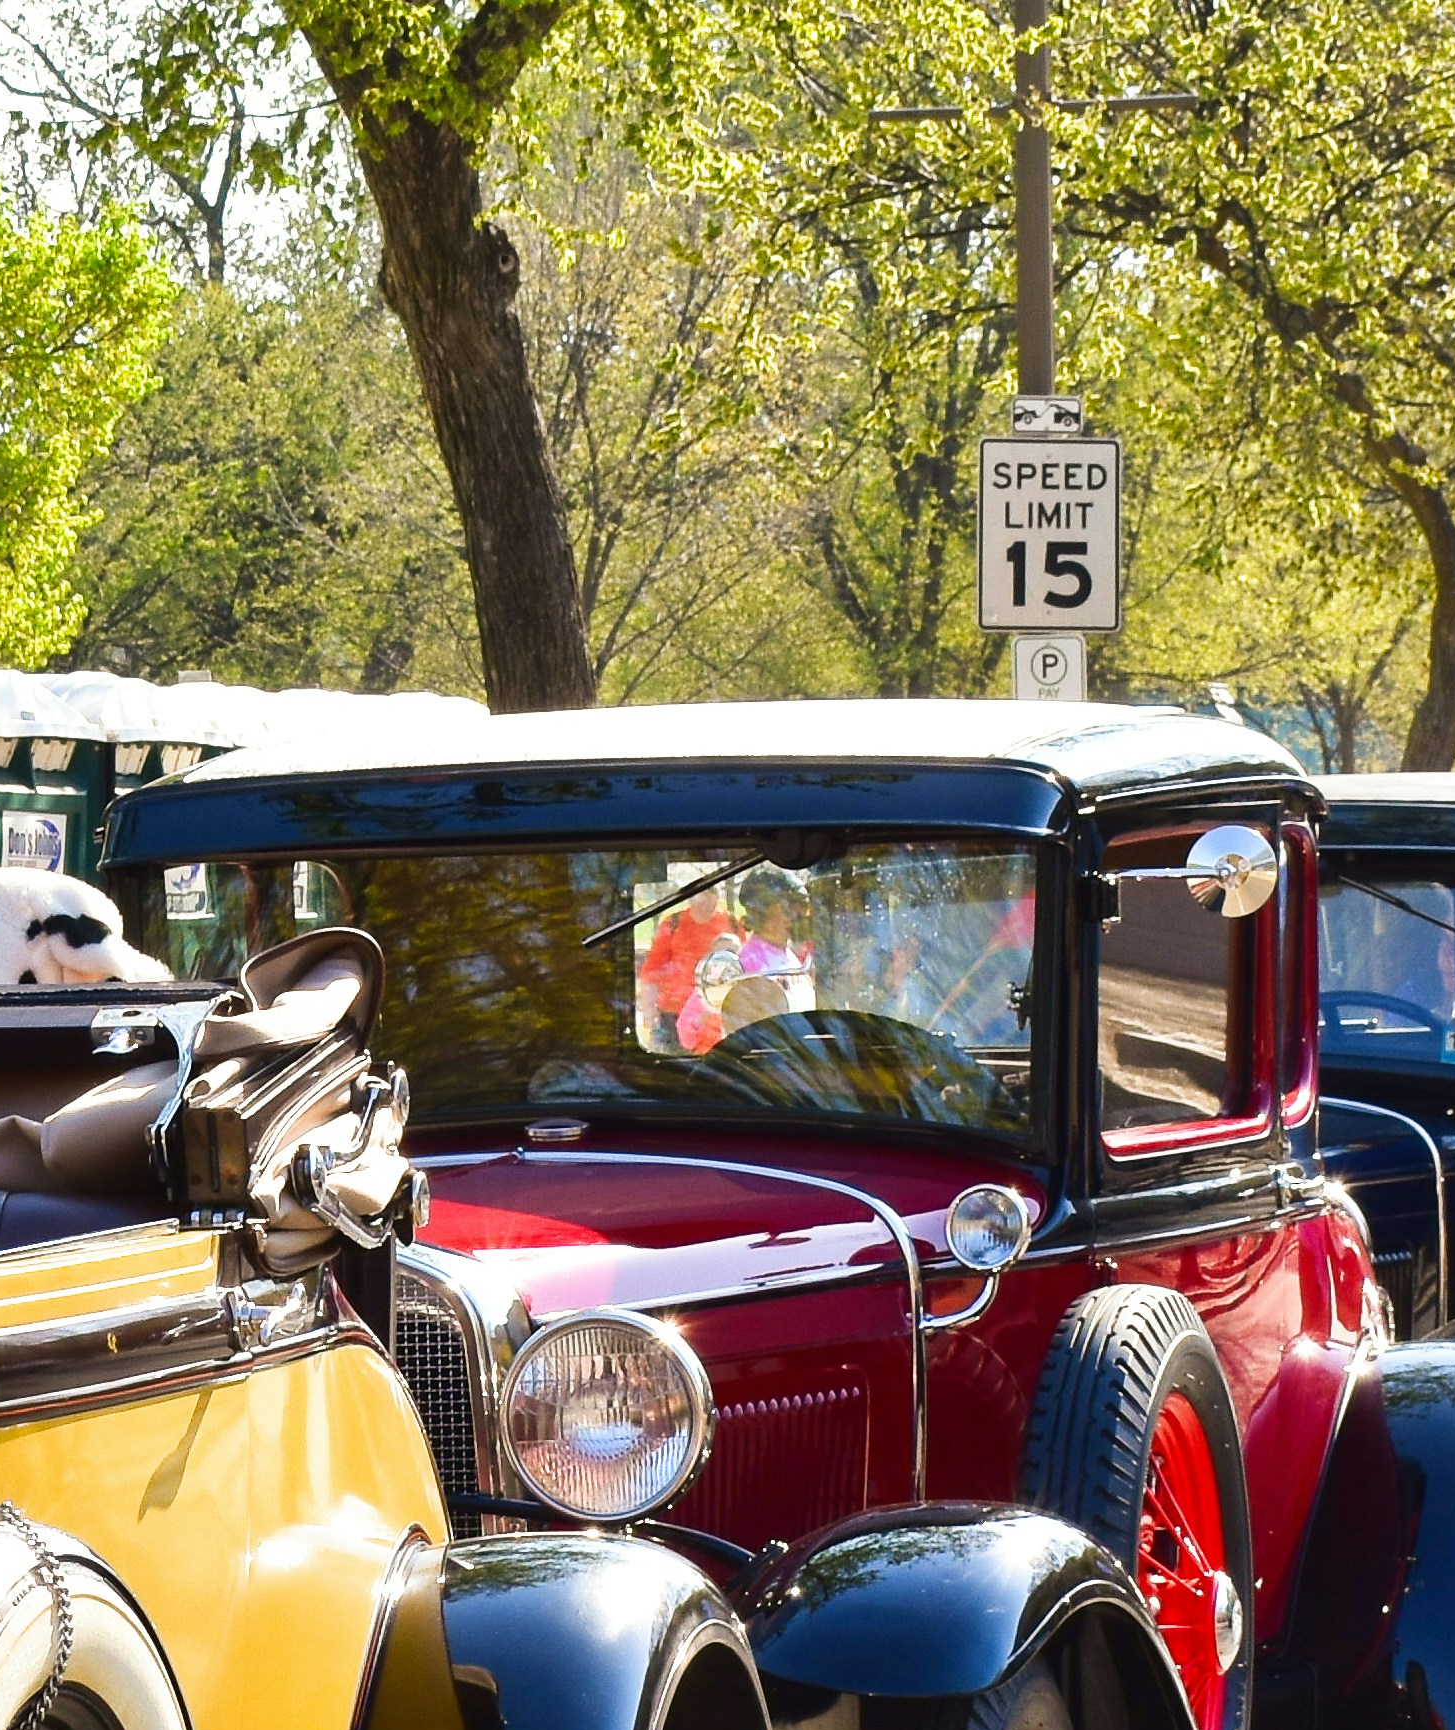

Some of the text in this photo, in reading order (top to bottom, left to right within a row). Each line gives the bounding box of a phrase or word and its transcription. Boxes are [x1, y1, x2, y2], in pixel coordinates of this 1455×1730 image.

[993, 461, 1107, 491] SPEED
[1005, 501, 1093, 529] LIMIT
[1006, 540, 1092, 609] 15
[1042, 653, 1059, 679] P
